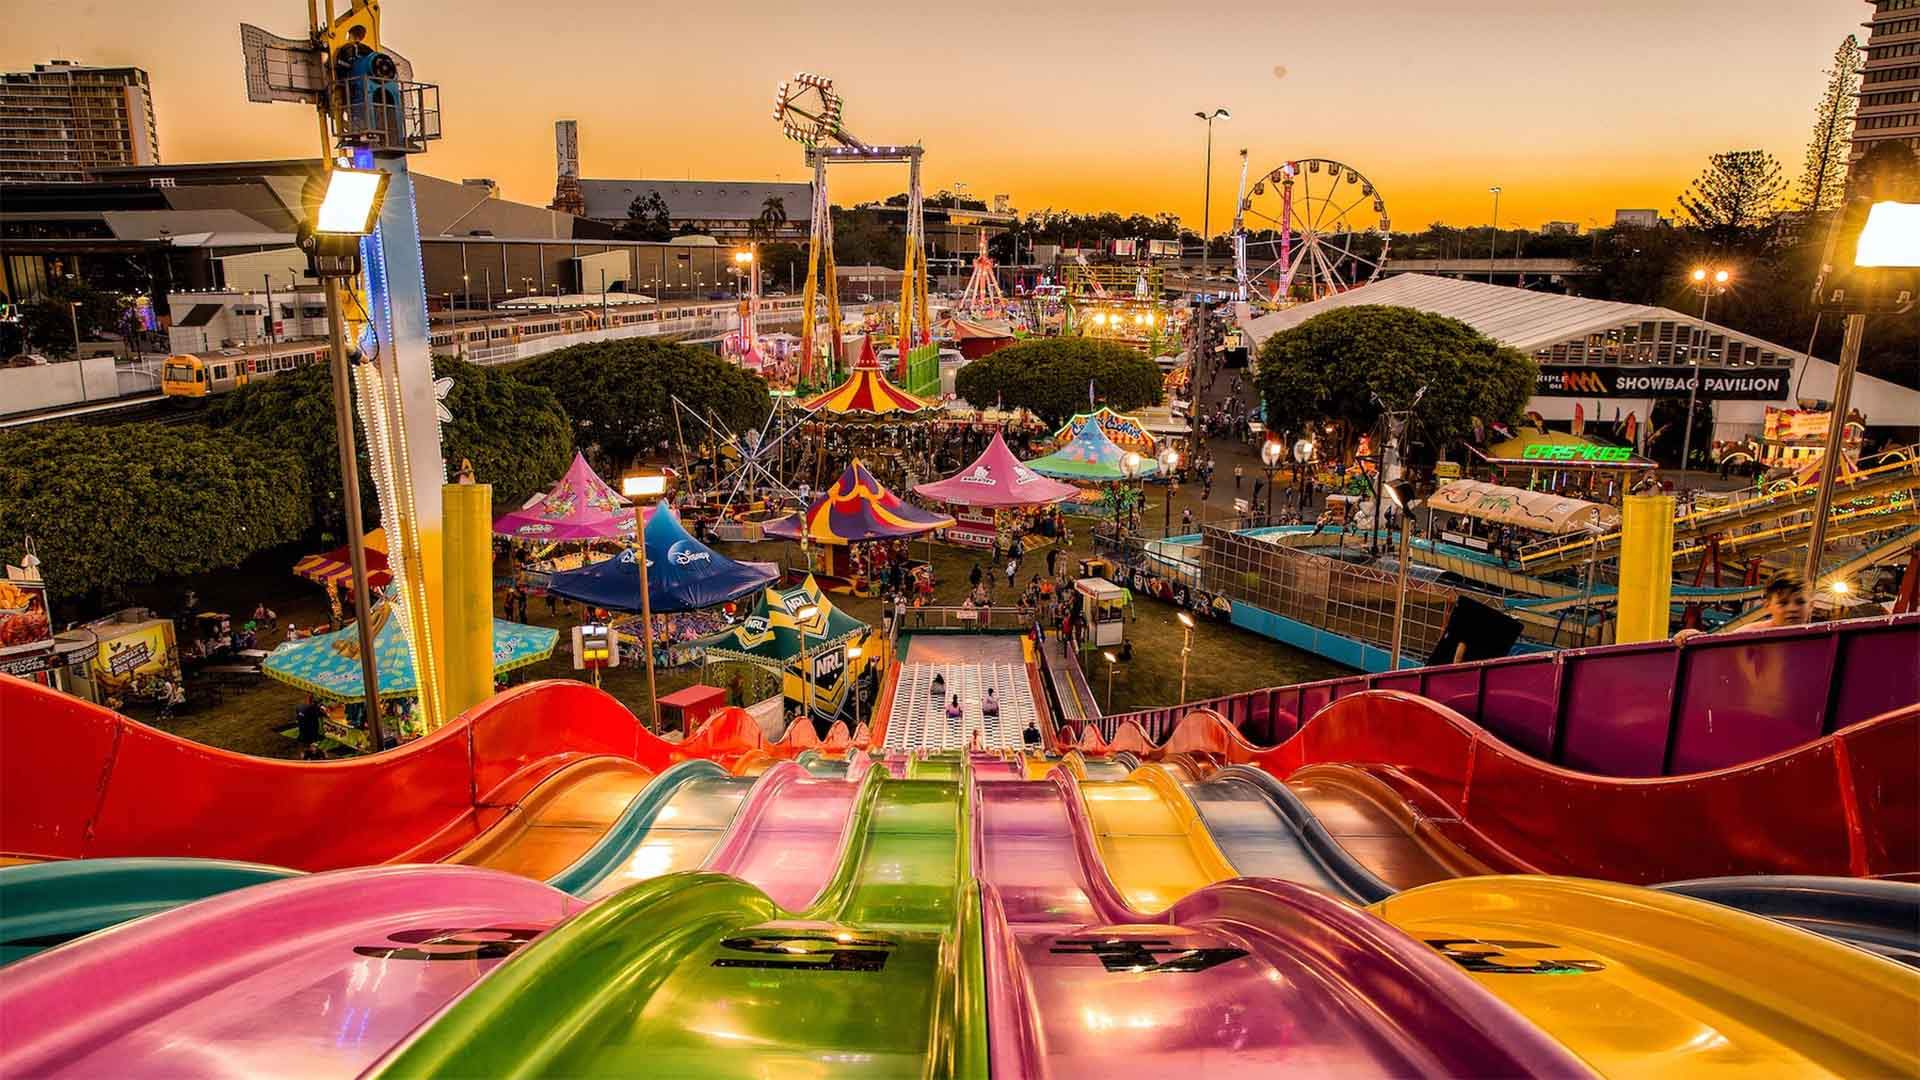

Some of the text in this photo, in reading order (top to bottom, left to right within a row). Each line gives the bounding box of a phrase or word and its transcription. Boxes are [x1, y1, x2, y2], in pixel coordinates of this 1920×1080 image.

[1534, 375, 1569, 383] RIPLE
[1616, 376, 1780, 392] SHOWBAG PAVILION
[675, 550, 711, 565] Disney
[785, 594, 812, 613] NRL
[746, 618, 768, 632] NRL
[816, 652, 844, 679] NRL
